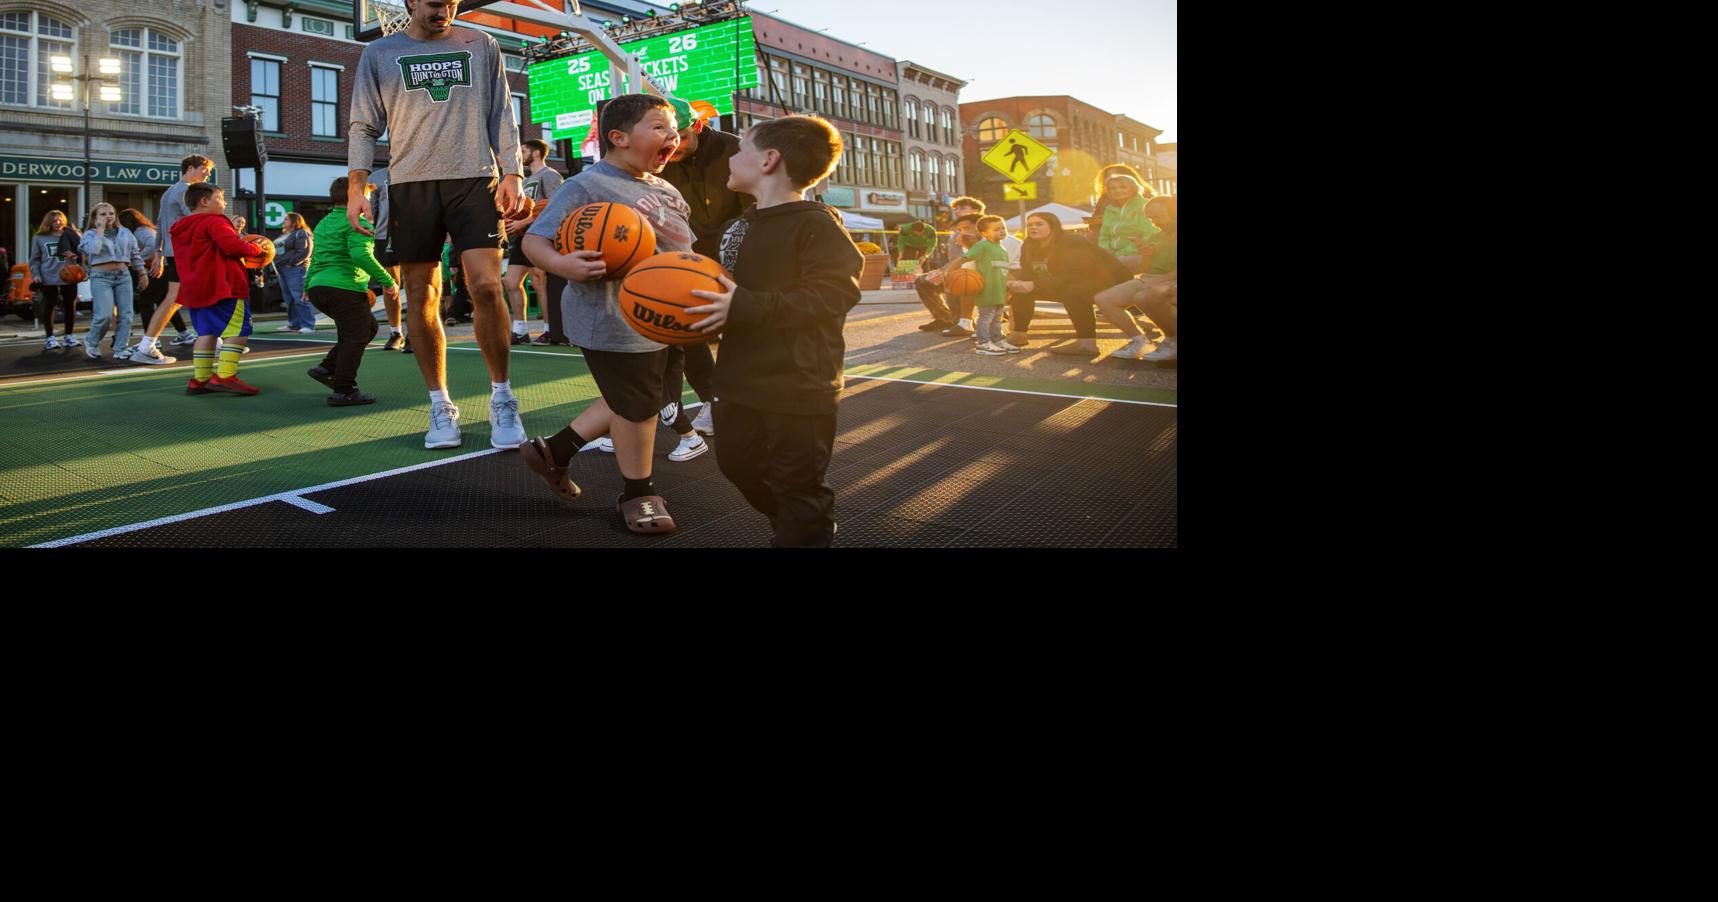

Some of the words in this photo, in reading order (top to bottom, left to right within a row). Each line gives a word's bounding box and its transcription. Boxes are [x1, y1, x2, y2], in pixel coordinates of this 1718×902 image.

[409, 60, 463, 72] HOOPS
[567, 56, 591, 75] 25
[668, 33, 697, 54] 26
[578, 69, 626, 91] SEAS
[640, 54, 689, 77] CKETS
[588, 87, 605, 105] ON
[2, 162, 99, 178] DERWOOD
[106, 165, 142, 179] LAW
[146, 167, 184, 182] OFFI
[633, 301, 702, 333] Wilso
